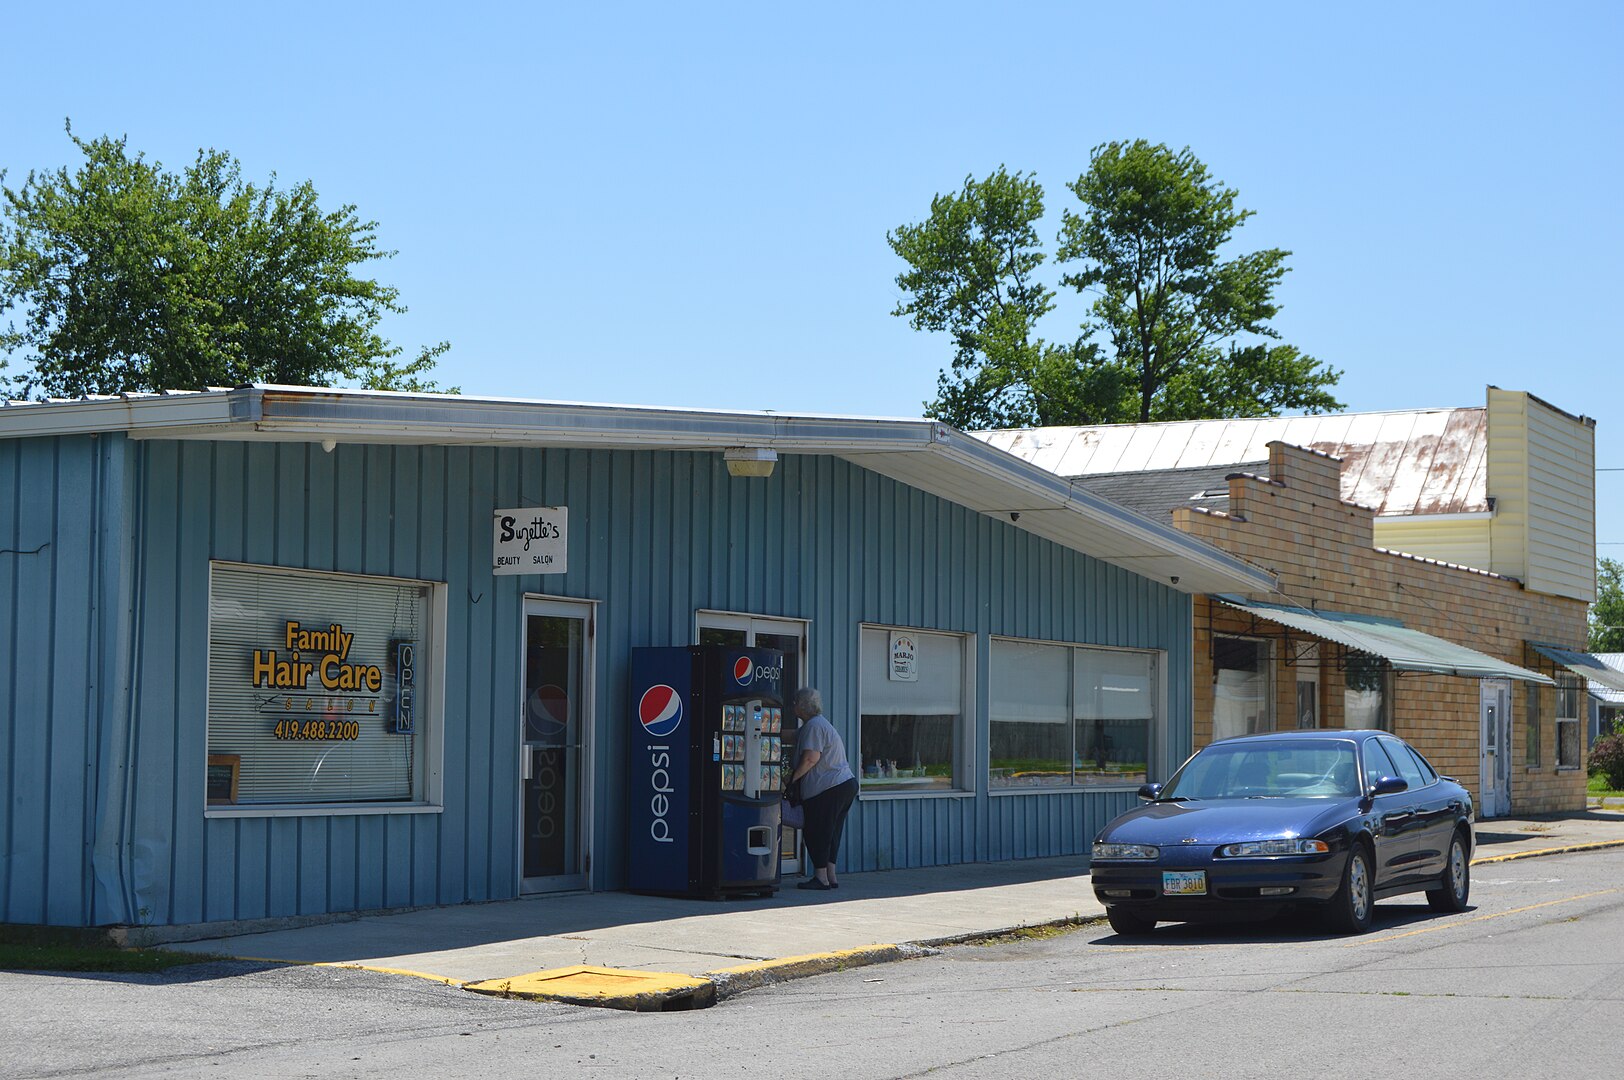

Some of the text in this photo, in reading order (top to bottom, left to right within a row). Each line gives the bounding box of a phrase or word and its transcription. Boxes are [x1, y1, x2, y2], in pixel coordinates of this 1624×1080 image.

[500, 515, 560, 552] Suzette's
[497, 555, 554, 566] BEAUTY SALON
[285, 620, 354, 662] Family
[894, 652, 914, 660] MARJO
[253, 649, 382, 692] Hair Care
[755, 665, 780, 683] pepsi
[400, 646, 414, 730] OPEN
[285, 697, 376, 713] SALON
[274, 719, 360, 742] 419.488.2200
[647, 745, 675, 843] pepsi
[1165, 877, 1204, 890] FBR 3810
